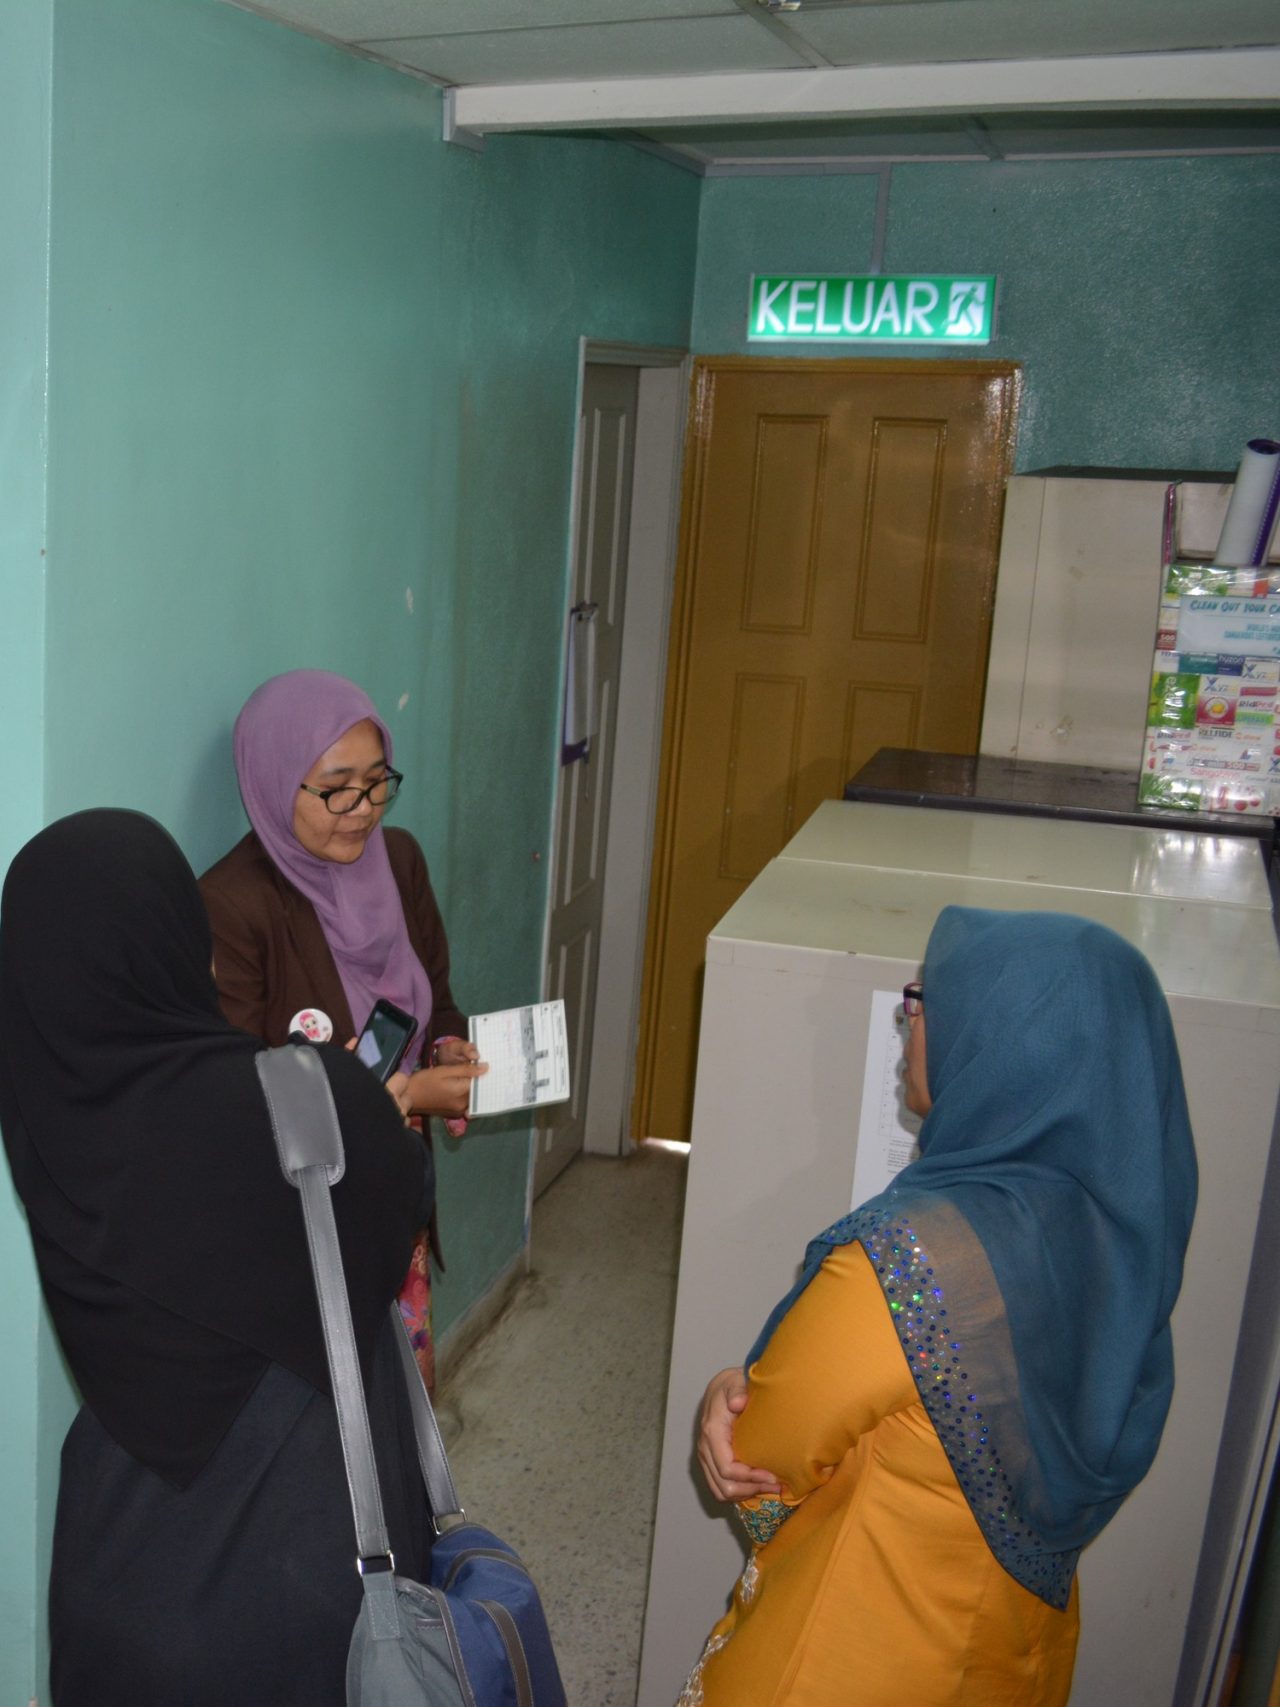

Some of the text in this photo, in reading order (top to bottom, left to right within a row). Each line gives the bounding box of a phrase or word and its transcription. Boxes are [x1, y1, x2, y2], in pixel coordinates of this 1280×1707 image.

[756, 280, 939, 335] KELUAR
[1190, 600, 1218, 611] CLEAN
[1221, 601, 1241, 612] OUT
